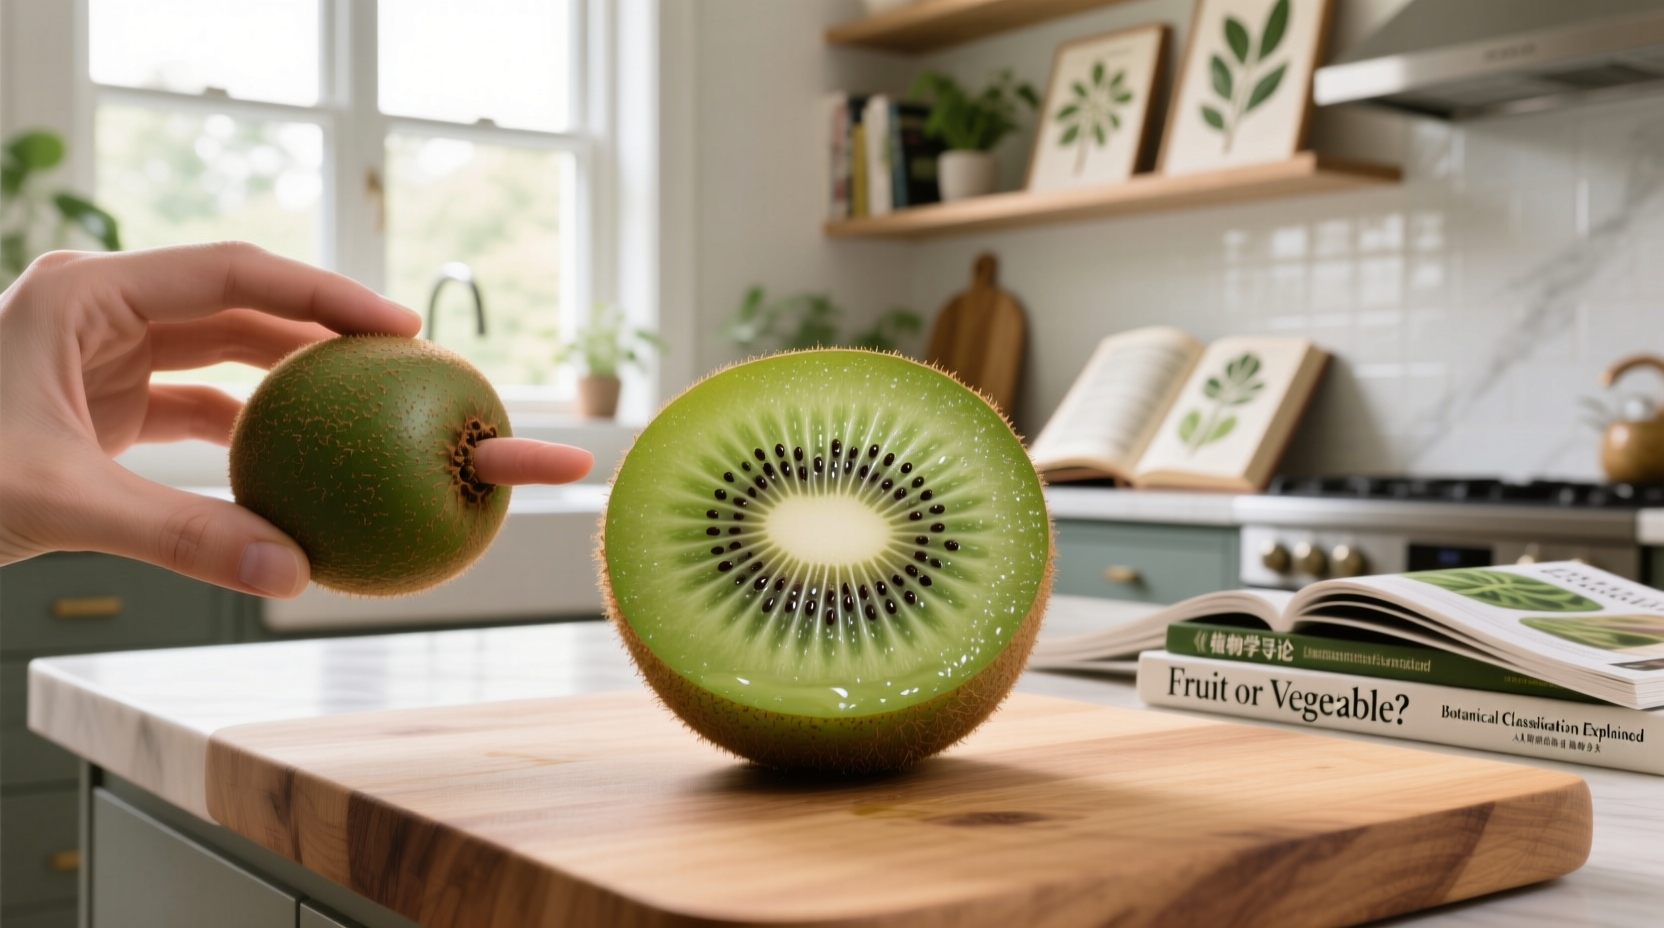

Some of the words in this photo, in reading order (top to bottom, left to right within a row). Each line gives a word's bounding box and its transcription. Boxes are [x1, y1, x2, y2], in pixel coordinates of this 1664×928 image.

[1168, 666, 1229, 701] Fruit
[1234, 684, 1264, 706] or
[1270, 679, 1410, 726] Vegeable?
[1441, 704, 1499, 725] Botanical
